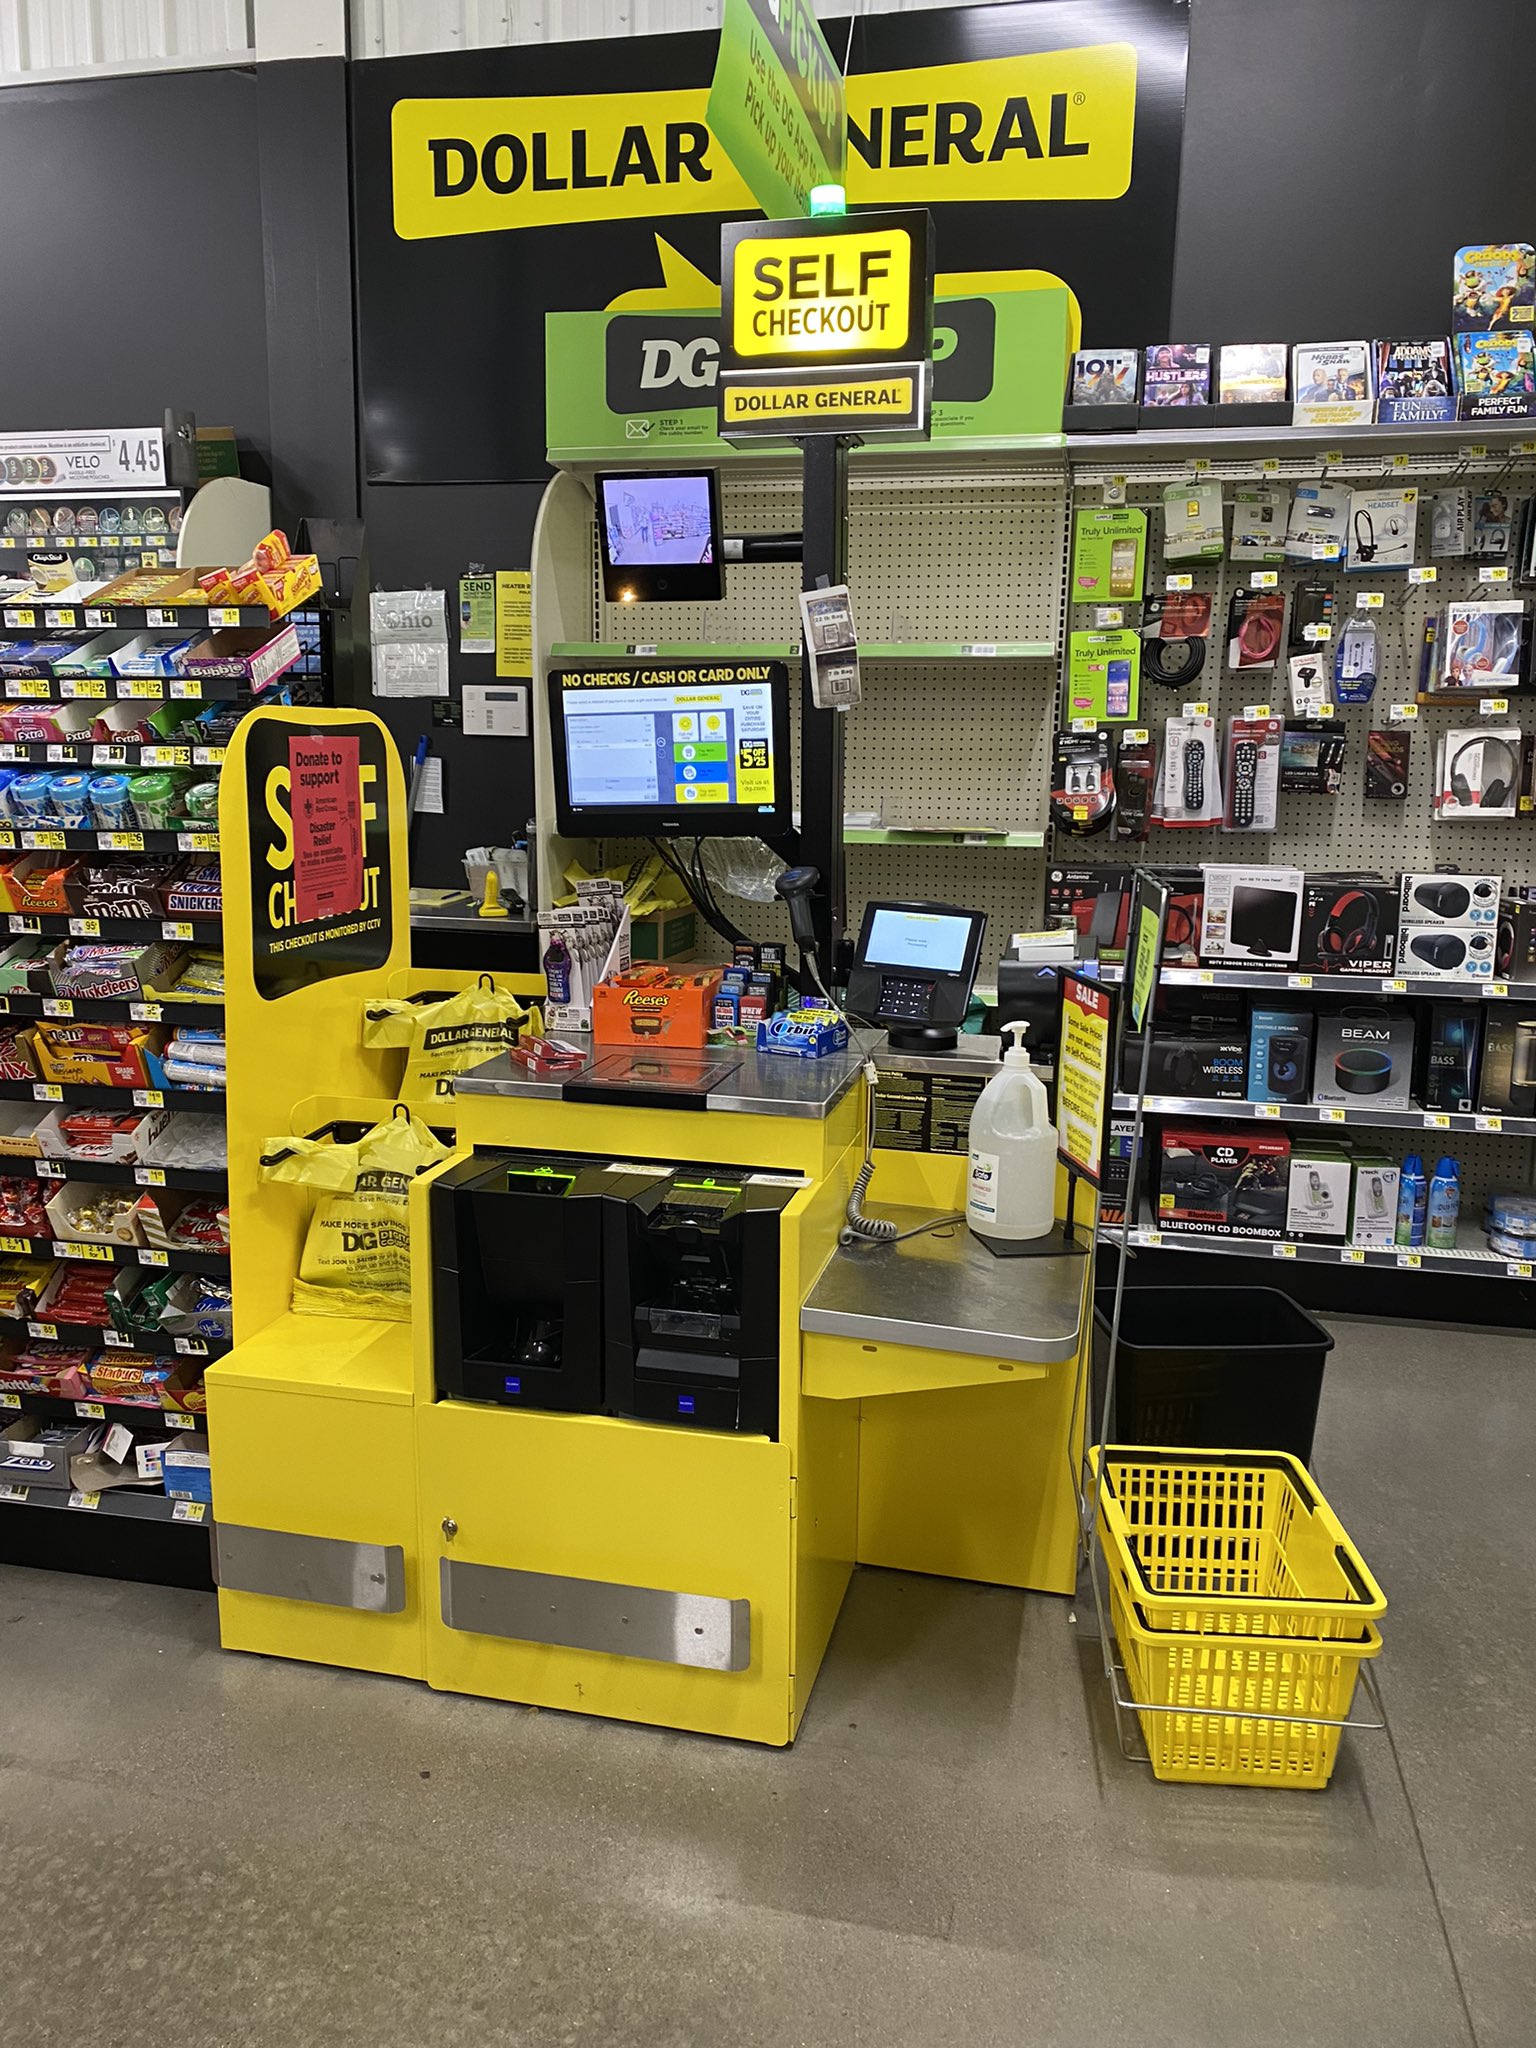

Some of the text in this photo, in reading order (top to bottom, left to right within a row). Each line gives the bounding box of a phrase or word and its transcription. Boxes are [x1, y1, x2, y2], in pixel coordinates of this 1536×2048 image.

[750, 30, 818, 185] Use the DG App to
[745, 78, 764, 137] Pick
[764, 120, 776, 156] up
[775, 142, 795, 193] your
[428, 93, 1090, 198] DOLLAR NERAL
[752, 249, 892, 302] SELF
[752, 302, 890, 338] CHECKOUT
[1394, 345, 1433, 356] ADDAMS
[640, 337, 720, 389] DG
[1311, 353, 1344, 361] HOBBS
[1077, 358, 1131, 386] 1917
[1146, 370, 1208, 382] HUSTLERS
[734, 387, 902, 412] DOLLAR GENERAL
[1477, 396, 1523, 407] PERFECT
[1471, 404, 1528, 416] FAMILY FUN
[66, 455, 101, 468] VELO
[1404, 492, 1415, 502] $7
[1367, 500, 1400, 509] HEADSET
[1456, 496, 1466, 533] AIR PLAY
[1081, 525, 1143, 537] Truly Unlimited
[32, 552, 63, 562] ChapStick
[464, 582, 492, 592] SEND
[101, 609, 113, 622] $1
[164, 609, 174, 622] $1
[1075, 647, 1137, 659] Truly Unlimited
[190, 663, 244, 677] Bubble
[562, 666, 771, 686] NO CHECKS / CASH OR CARD ONLY
[18, 729, 44, 741] Extra
[65, 730, 92, 742] Extra
[16, 746, 26, 757] $1
[64, 746, 74, 758] $1
[110, 747, 122, 760] $1
[753, 748, 767, 757] OFF
[295, 751, 342, 767] Donate to
[299, 768, 340, 790] support
[743, 785, 767, 793] dg.com
[309, 821, 337, 834] Disaster
[312, 834, 332, 847] Relief
[1402, 876, 1413, 913] billboard
[21, 895, 59, 908] Reese's
[269, 917, 382, 954] THIS CHECKOUT IS MONITORED BY CCTV
[1398, 927, 1410, 964] billboard
[1348, 960, 1393, 969] VIPER
[67, 977, 140, 1000] Musketeers
[622, 988, 671, 1007] Reese's
[1075, 983, 1099, 1010] SALE
[740, 1007, 763, 1015] WHEW
[768, 1017, 816, 1039] Orbit
[1341, 1028, 1391, 1040] BEAM
[430, 1029, 469, 1045] DOLLAR
[1488, 1042, 1515, 1053] BASS
[1213, 1058, 1244, 1067] BOOM
[1430, 1055, 1455, 1066] BASS
[114, 1066, 136, 1075] SHARE
[1202, 1066, 1244, 1075] WIRELESS
[1324, 1094, 1346, 1102] Bluetooth
[1216, 1147, 1235, 1158] CD
[1210, 1156, 1239, 1165] PLAYER
[973, 1169, 990, 1181] Safe
[1187, 1210, 1224, 1220] Bluetooth
[320, 1221, 342, 1229] MAKE
[344, 1222, 369, 1230] MORE
[1160, 1220, 1282, 1238] BLUETOOTH CD BOOMBOX
[341, 1231, 379, 1252] DG
[104, 1353, 156, 1365] Starburst
[96, 1367, 143, 1382] Starburst
